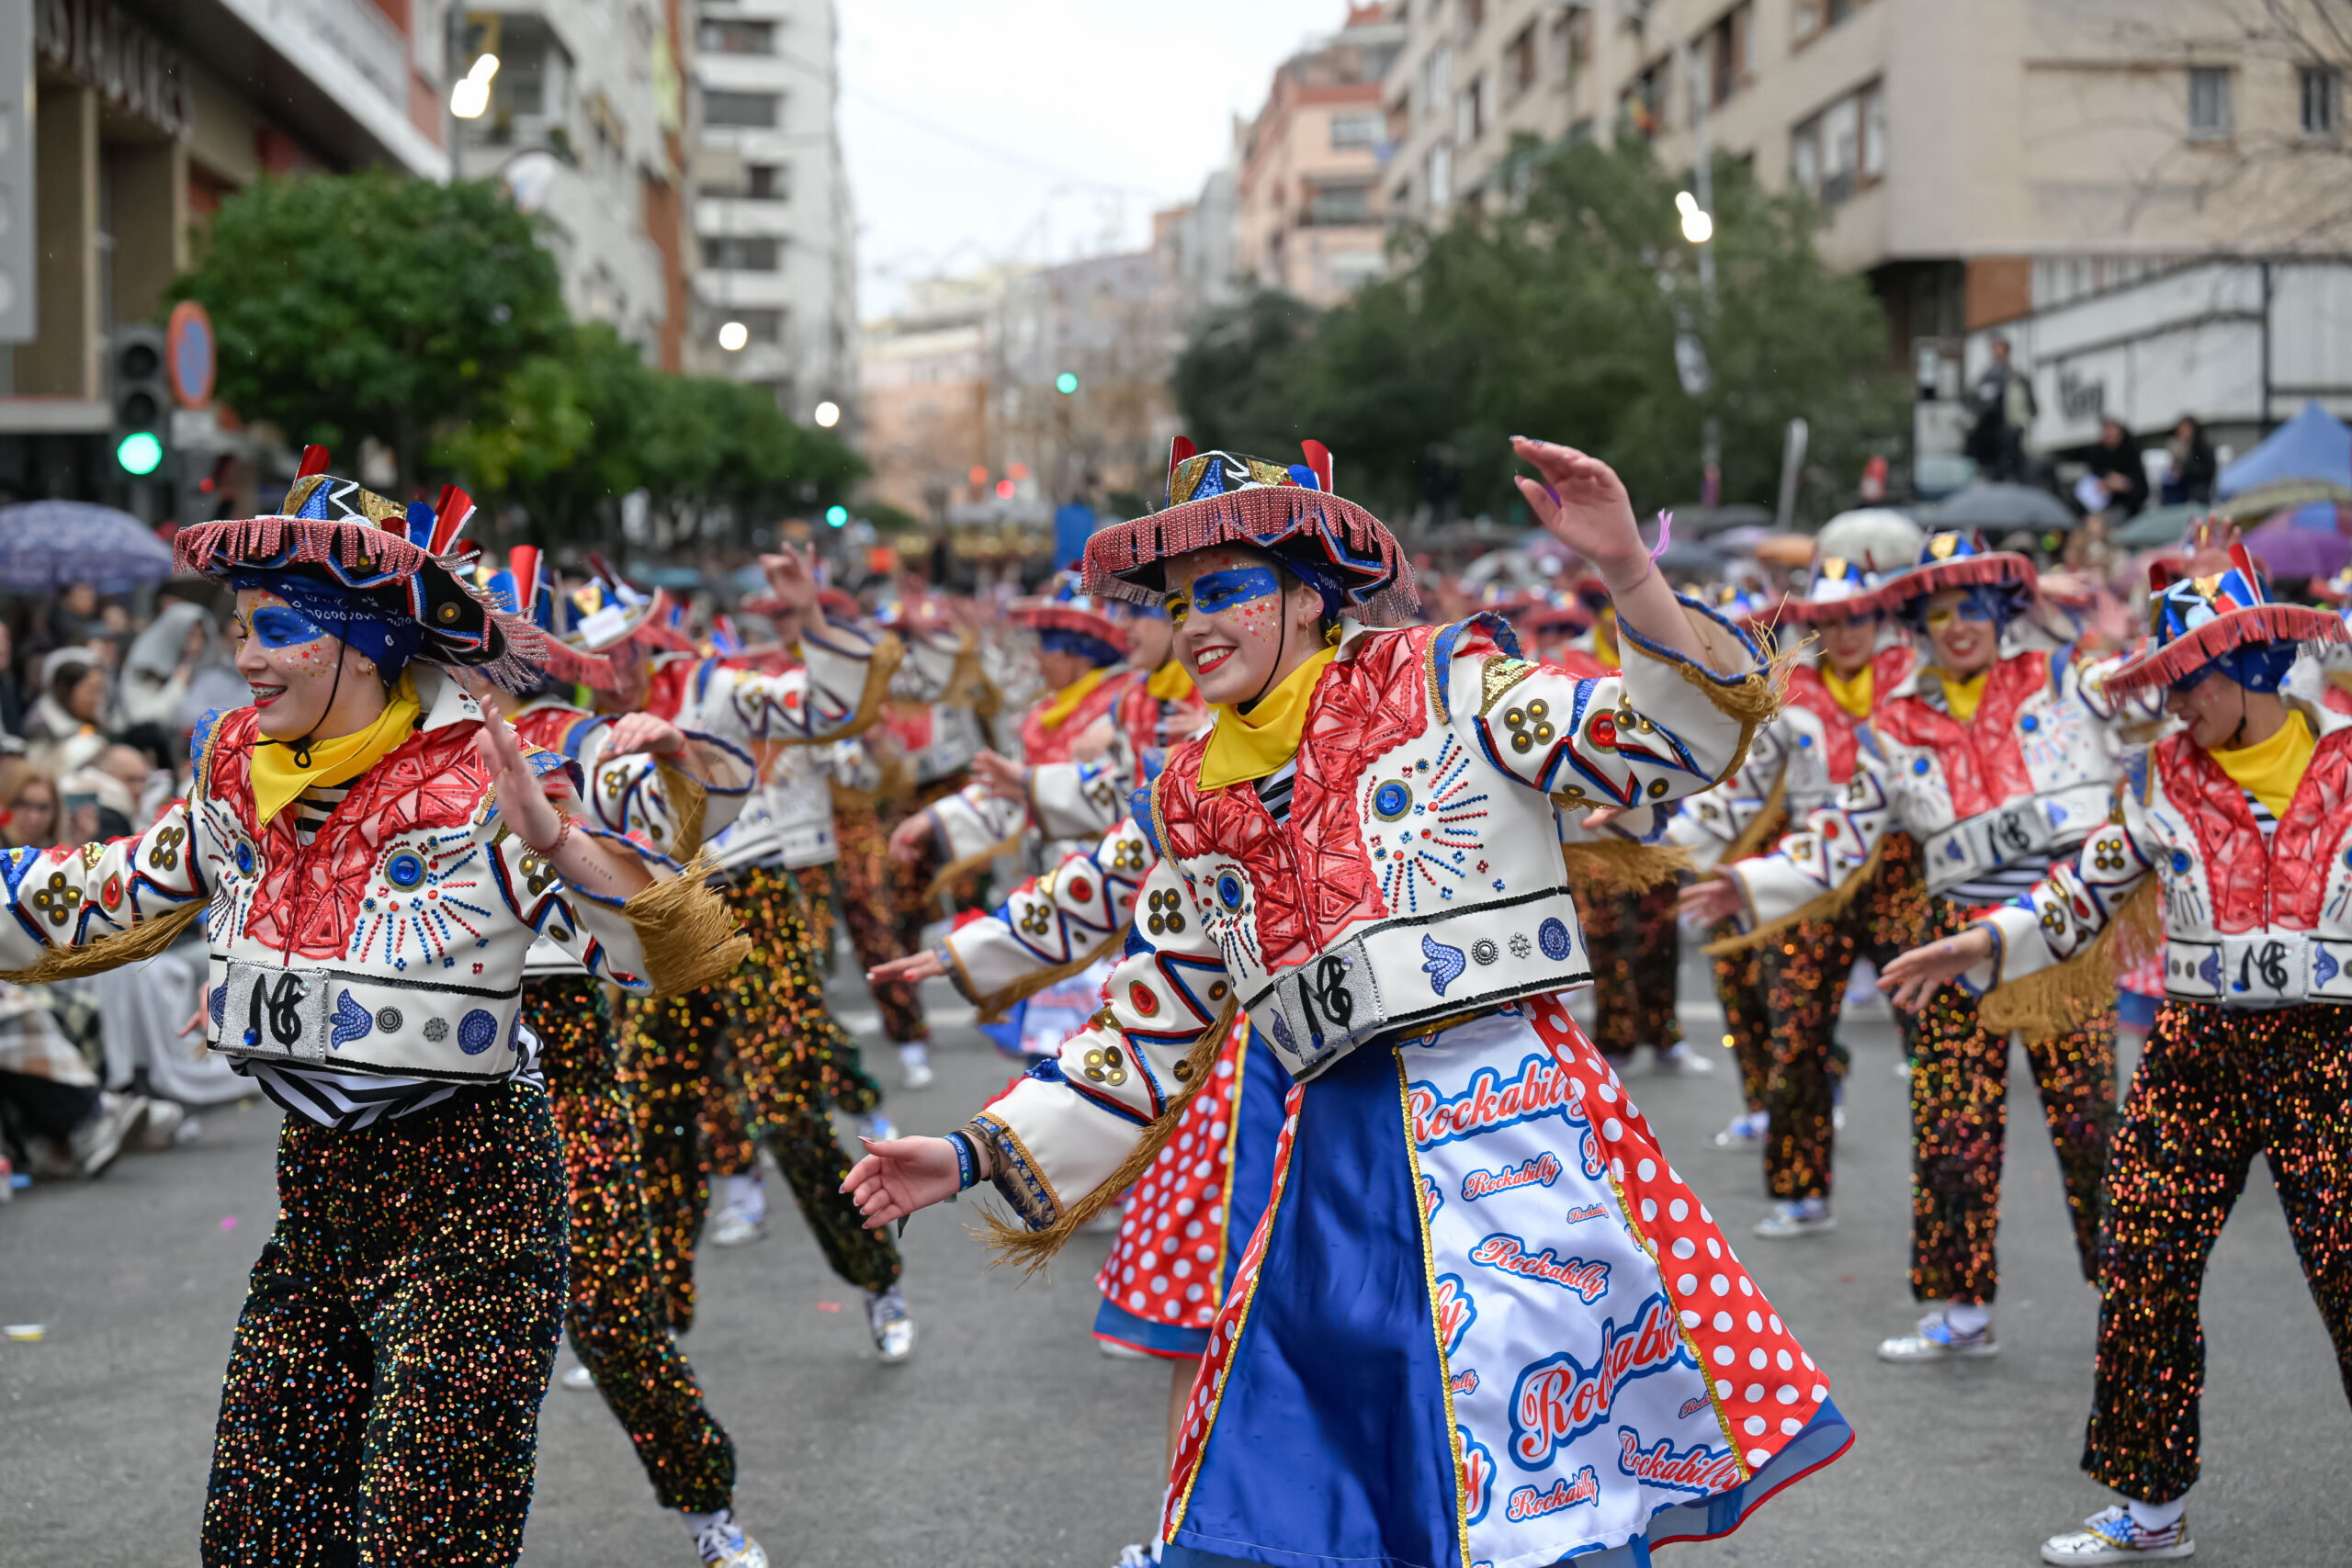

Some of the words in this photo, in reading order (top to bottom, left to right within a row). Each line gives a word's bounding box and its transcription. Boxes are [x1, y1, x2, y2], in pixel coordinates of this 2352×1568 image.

[1408, 1063, 1585, 1141] Rockabil
[1464, 1154, 1560, 1199] Rockabilly
[1474, 1237, 1609, 1300] Rockabilly
[1510, 1469, 1597, 1518] Rockabilly
